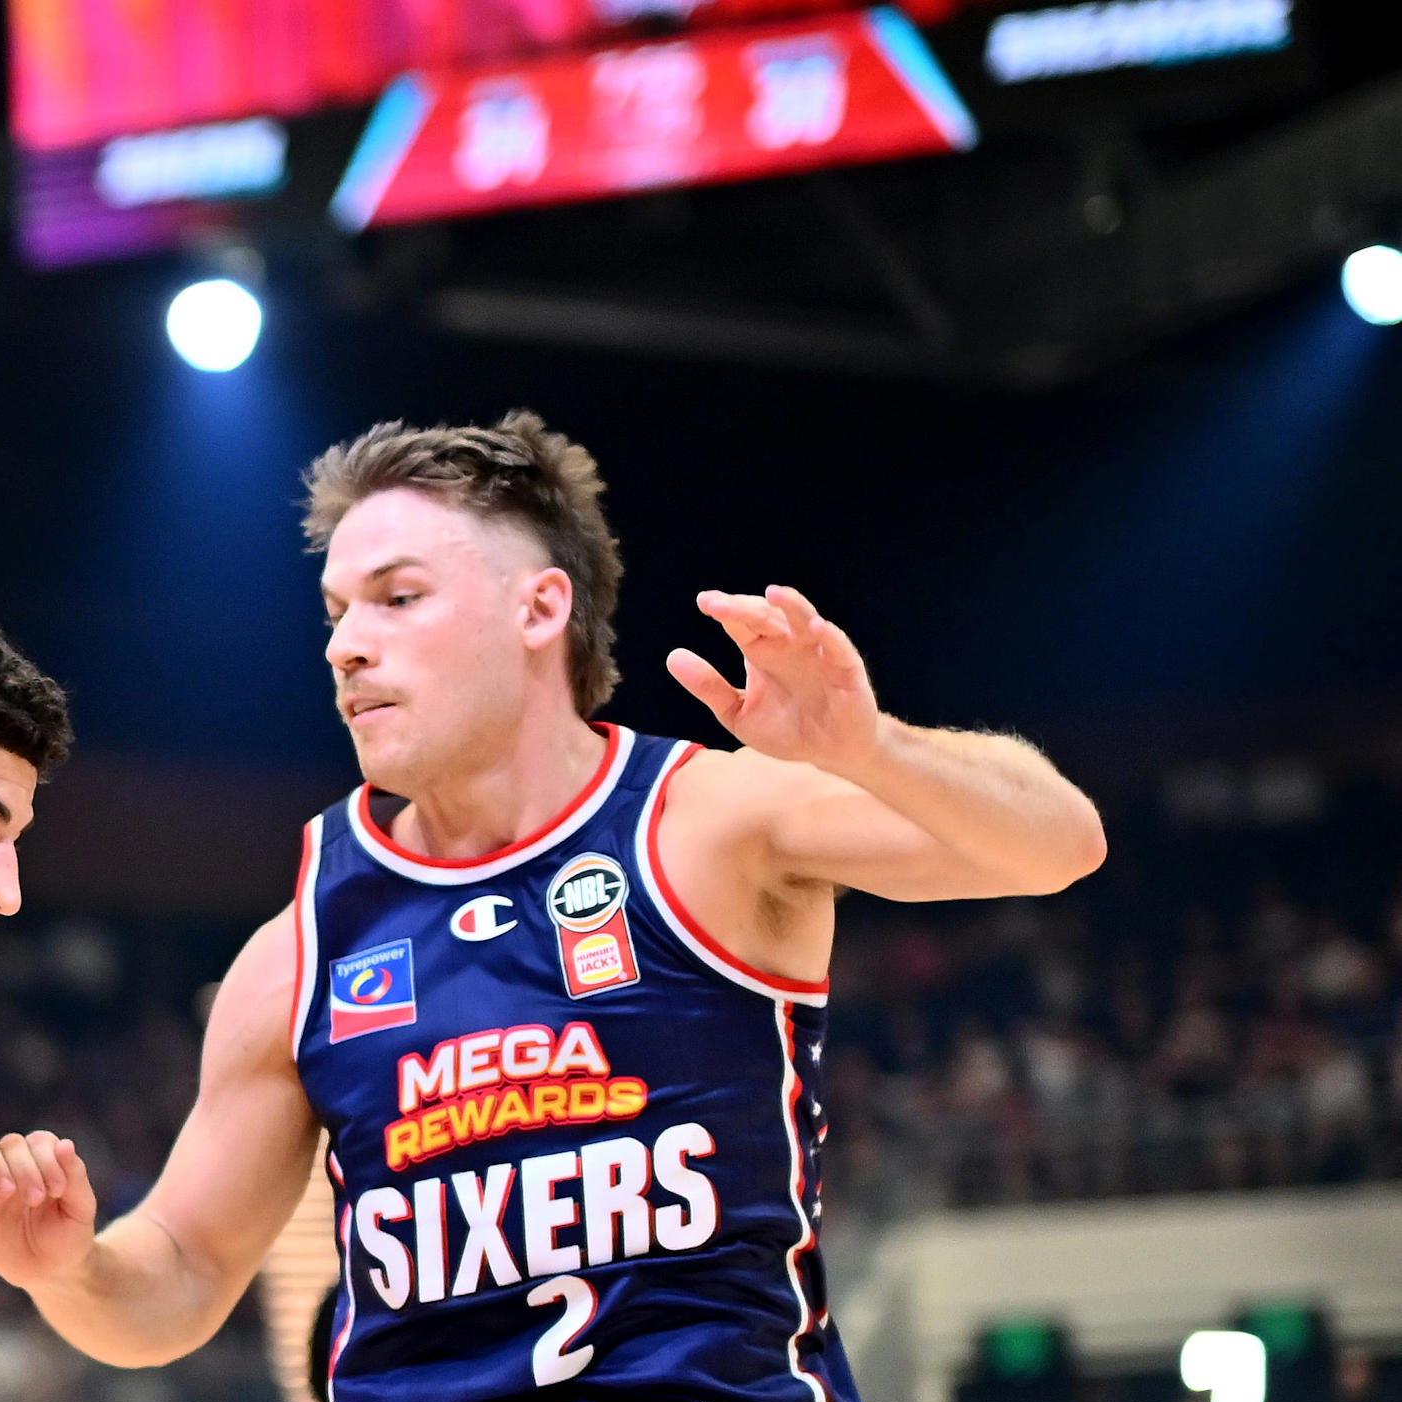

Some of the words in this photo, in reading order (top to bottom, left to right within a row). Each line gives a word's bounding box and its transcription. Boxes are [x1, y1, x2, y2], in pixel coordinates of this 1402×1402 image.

[563, 873, 611, 914] NBL
[336, 947, 406, 978] Tyrepower
[576, 946, 615, 962] HUNGRY
[398, 1022, 609, 1115] MEGA
[386, 1077, 647, 1170] REWARDS
[355, 1122, 721, 1311] SIXERS
[526, 1274, 597, 1388] 2
